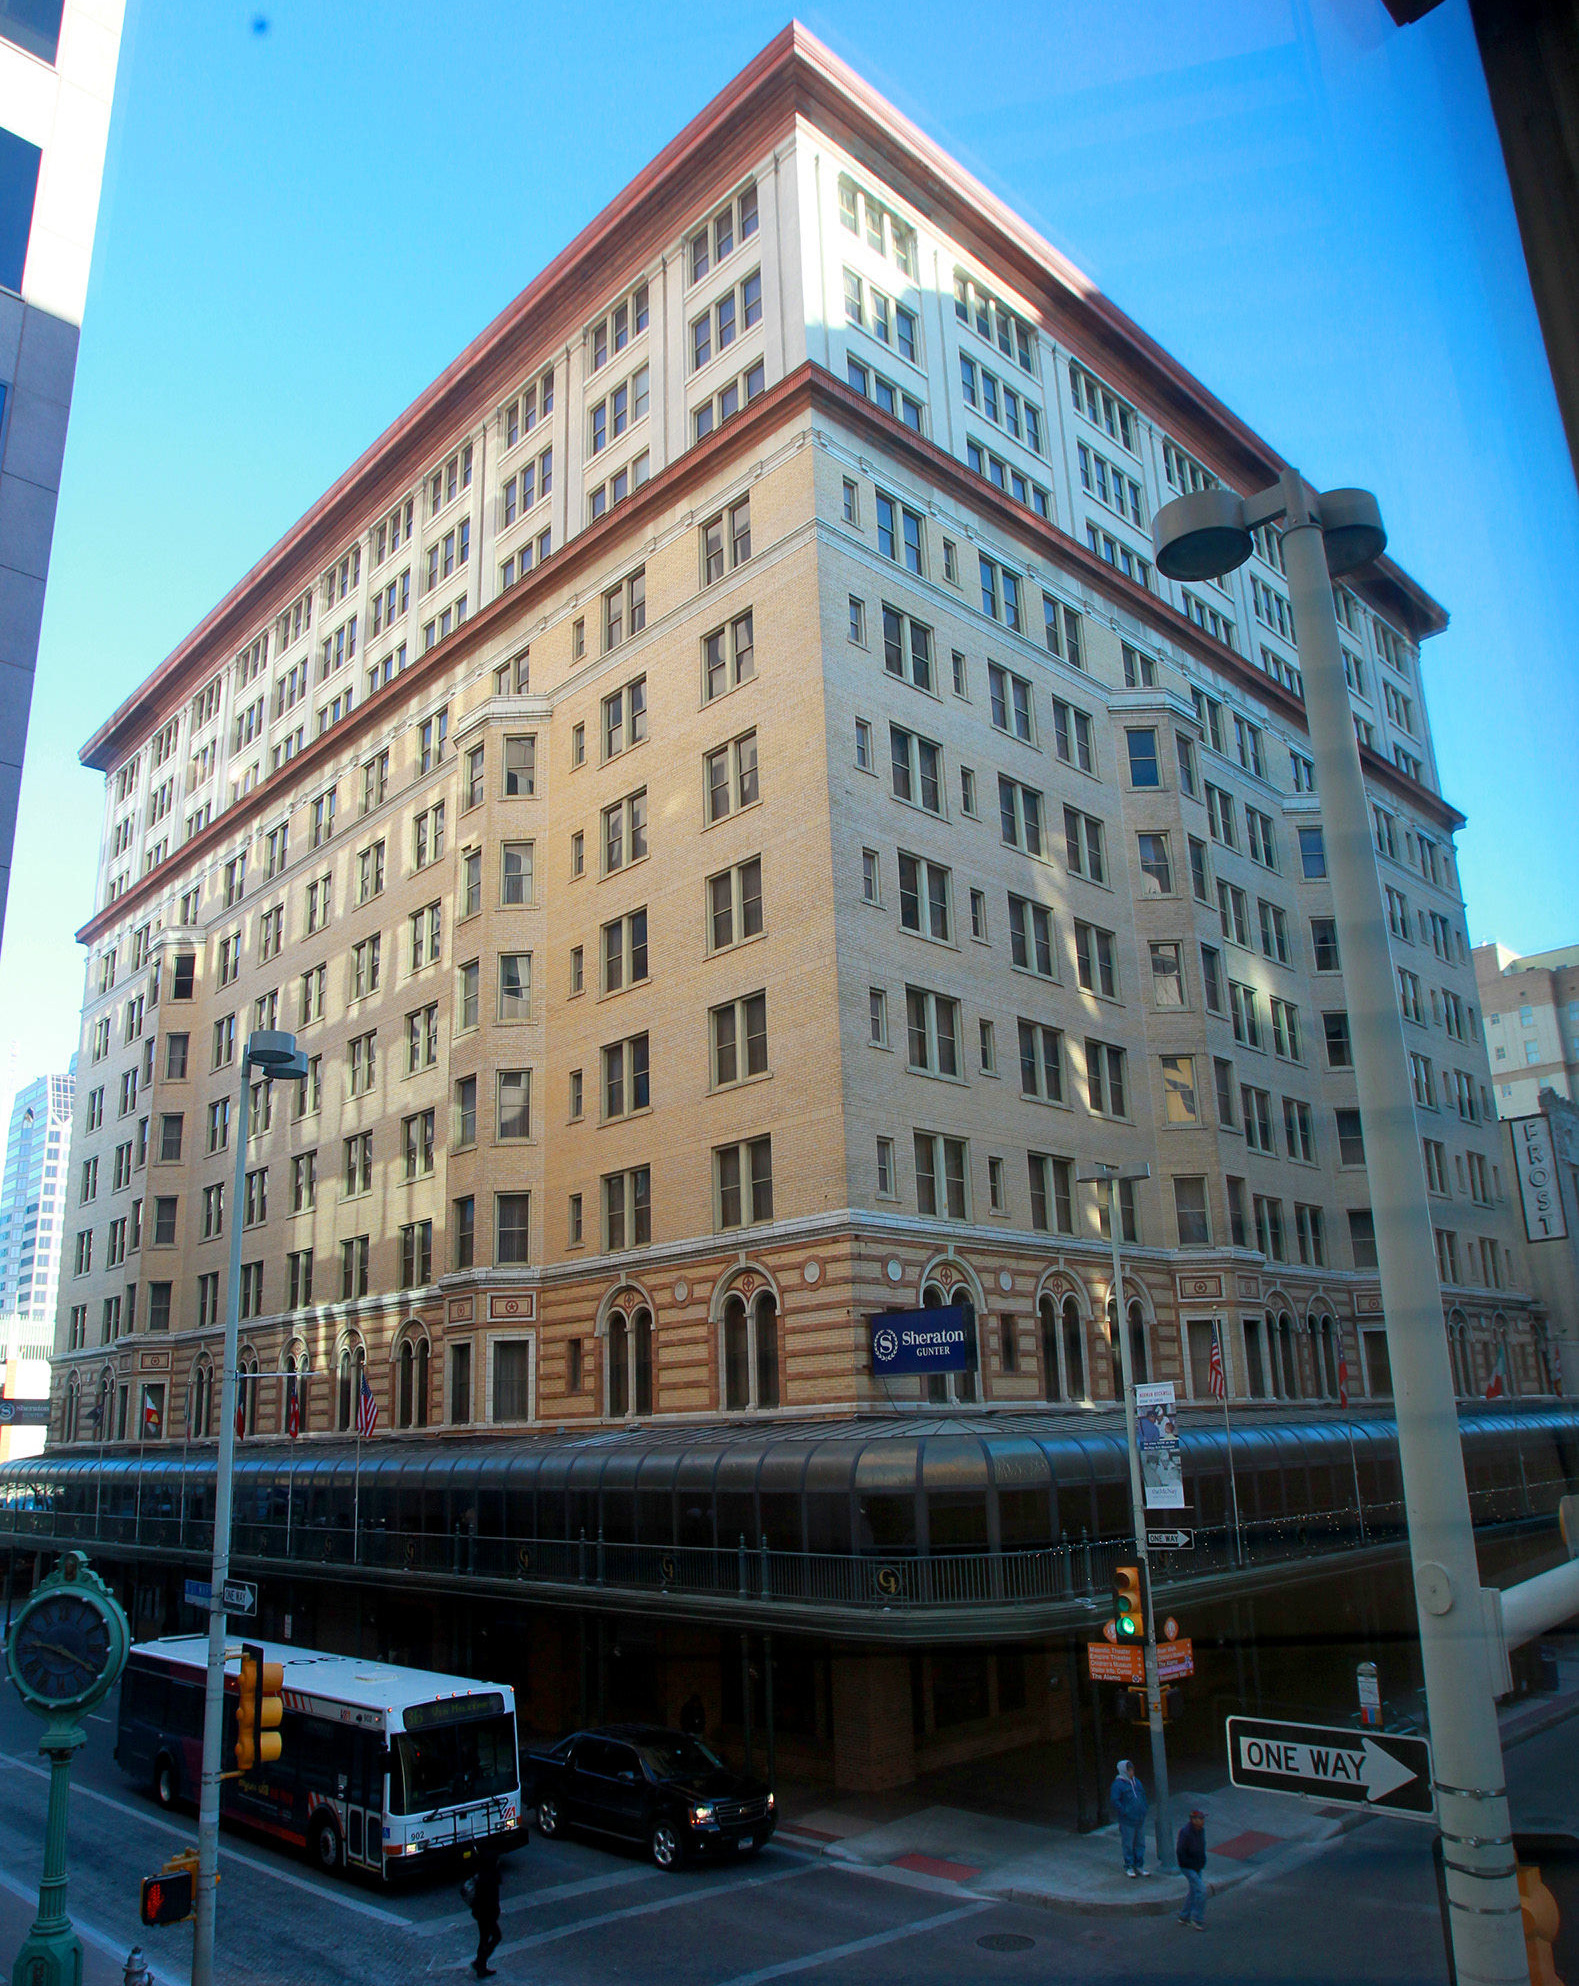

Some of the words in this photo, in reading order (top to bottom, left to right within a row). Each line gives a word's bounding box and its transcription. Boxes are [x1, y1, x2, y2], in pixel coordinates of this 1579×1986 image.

[1523, 1121, 1554, 1236] FROST
[901, 1329, 965, 1346] Sheraton
[916, 1346, 951, 1357] GUNTER
[1149, 1534, 1163, 1543] ONE
[1164, 1534, 1179, 1543] WAY
[225, 1588, 235, 1601] ONE
[235, 1590, 247, 1603] WAY
[1111, 1647, 1131, 1655] Theater
[1110, 1653, 1131, 1661] Theater
[1103, 1673, 1121, 1681] Alamo
[1247, 1741, 1300, 1773] ONE
[1309, 1749, 1366, 1781] WAY
[411, 1830, 425, 1840] 902
